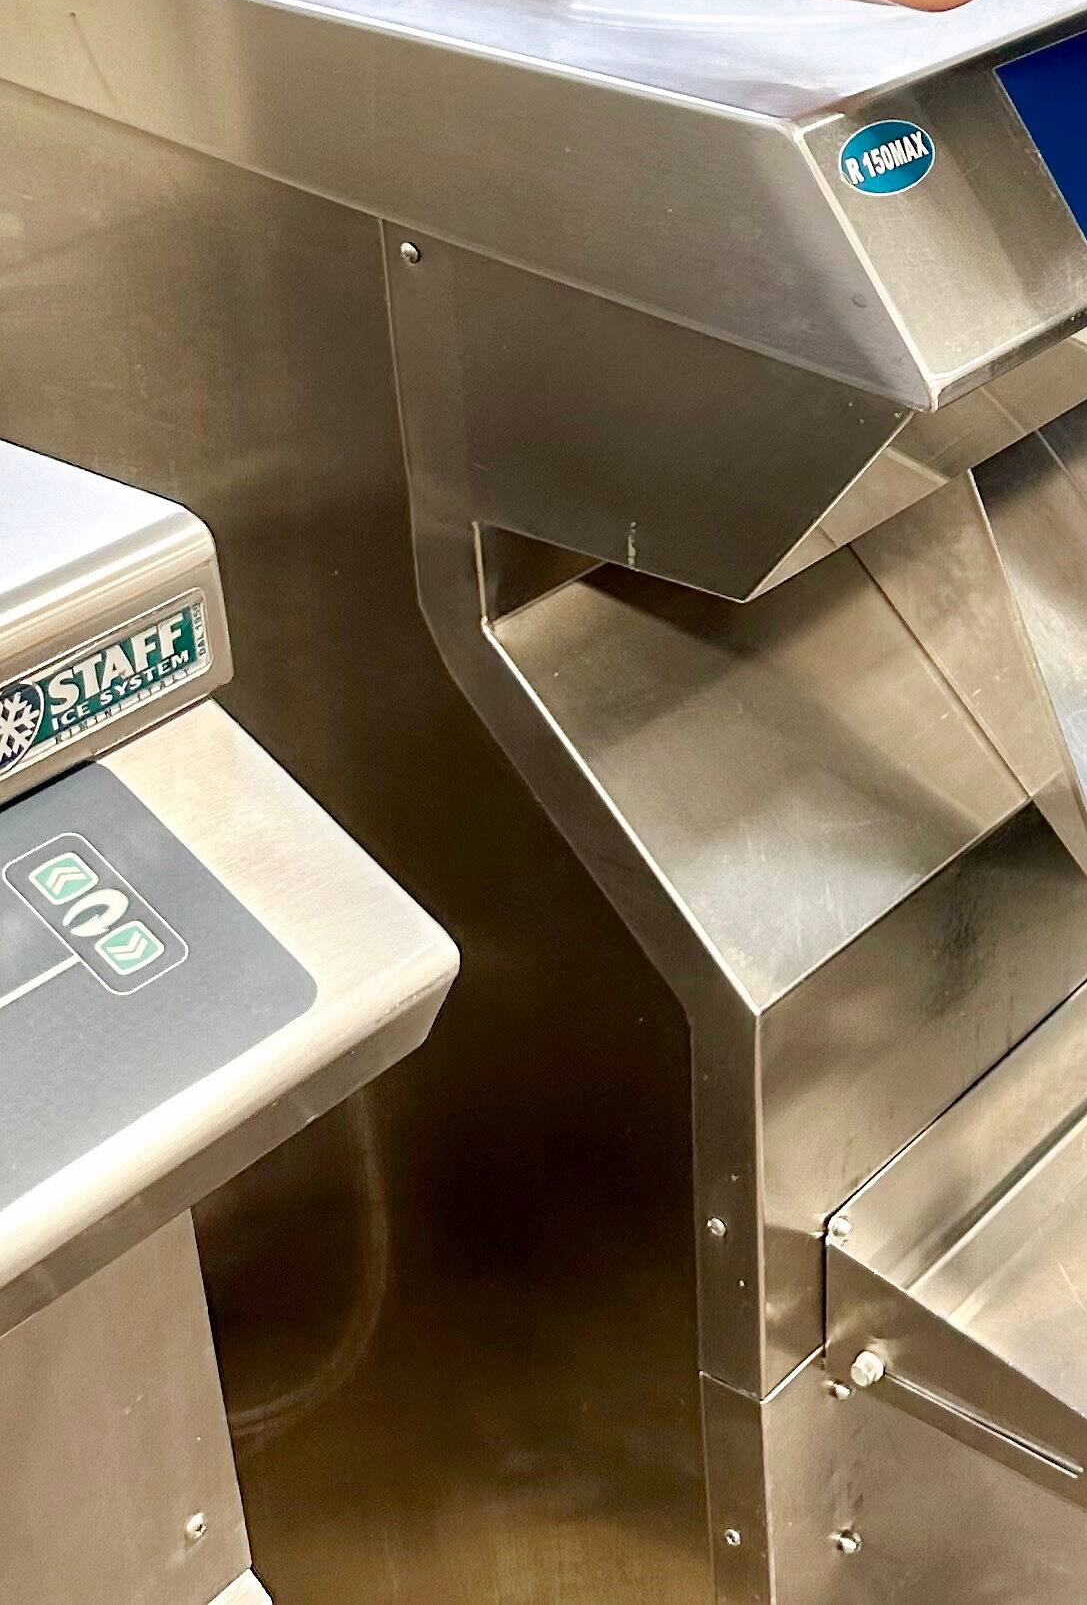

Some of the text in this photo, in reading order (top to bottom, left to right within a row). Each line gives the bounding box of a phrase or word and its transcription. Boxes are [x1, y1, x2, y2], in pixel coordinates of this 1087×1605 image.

[845, 130, 930, 185] R 150MAX
[48, 612, 185, 715] STAFF
[51, 650, 190, 731] ICE SYSTEM
